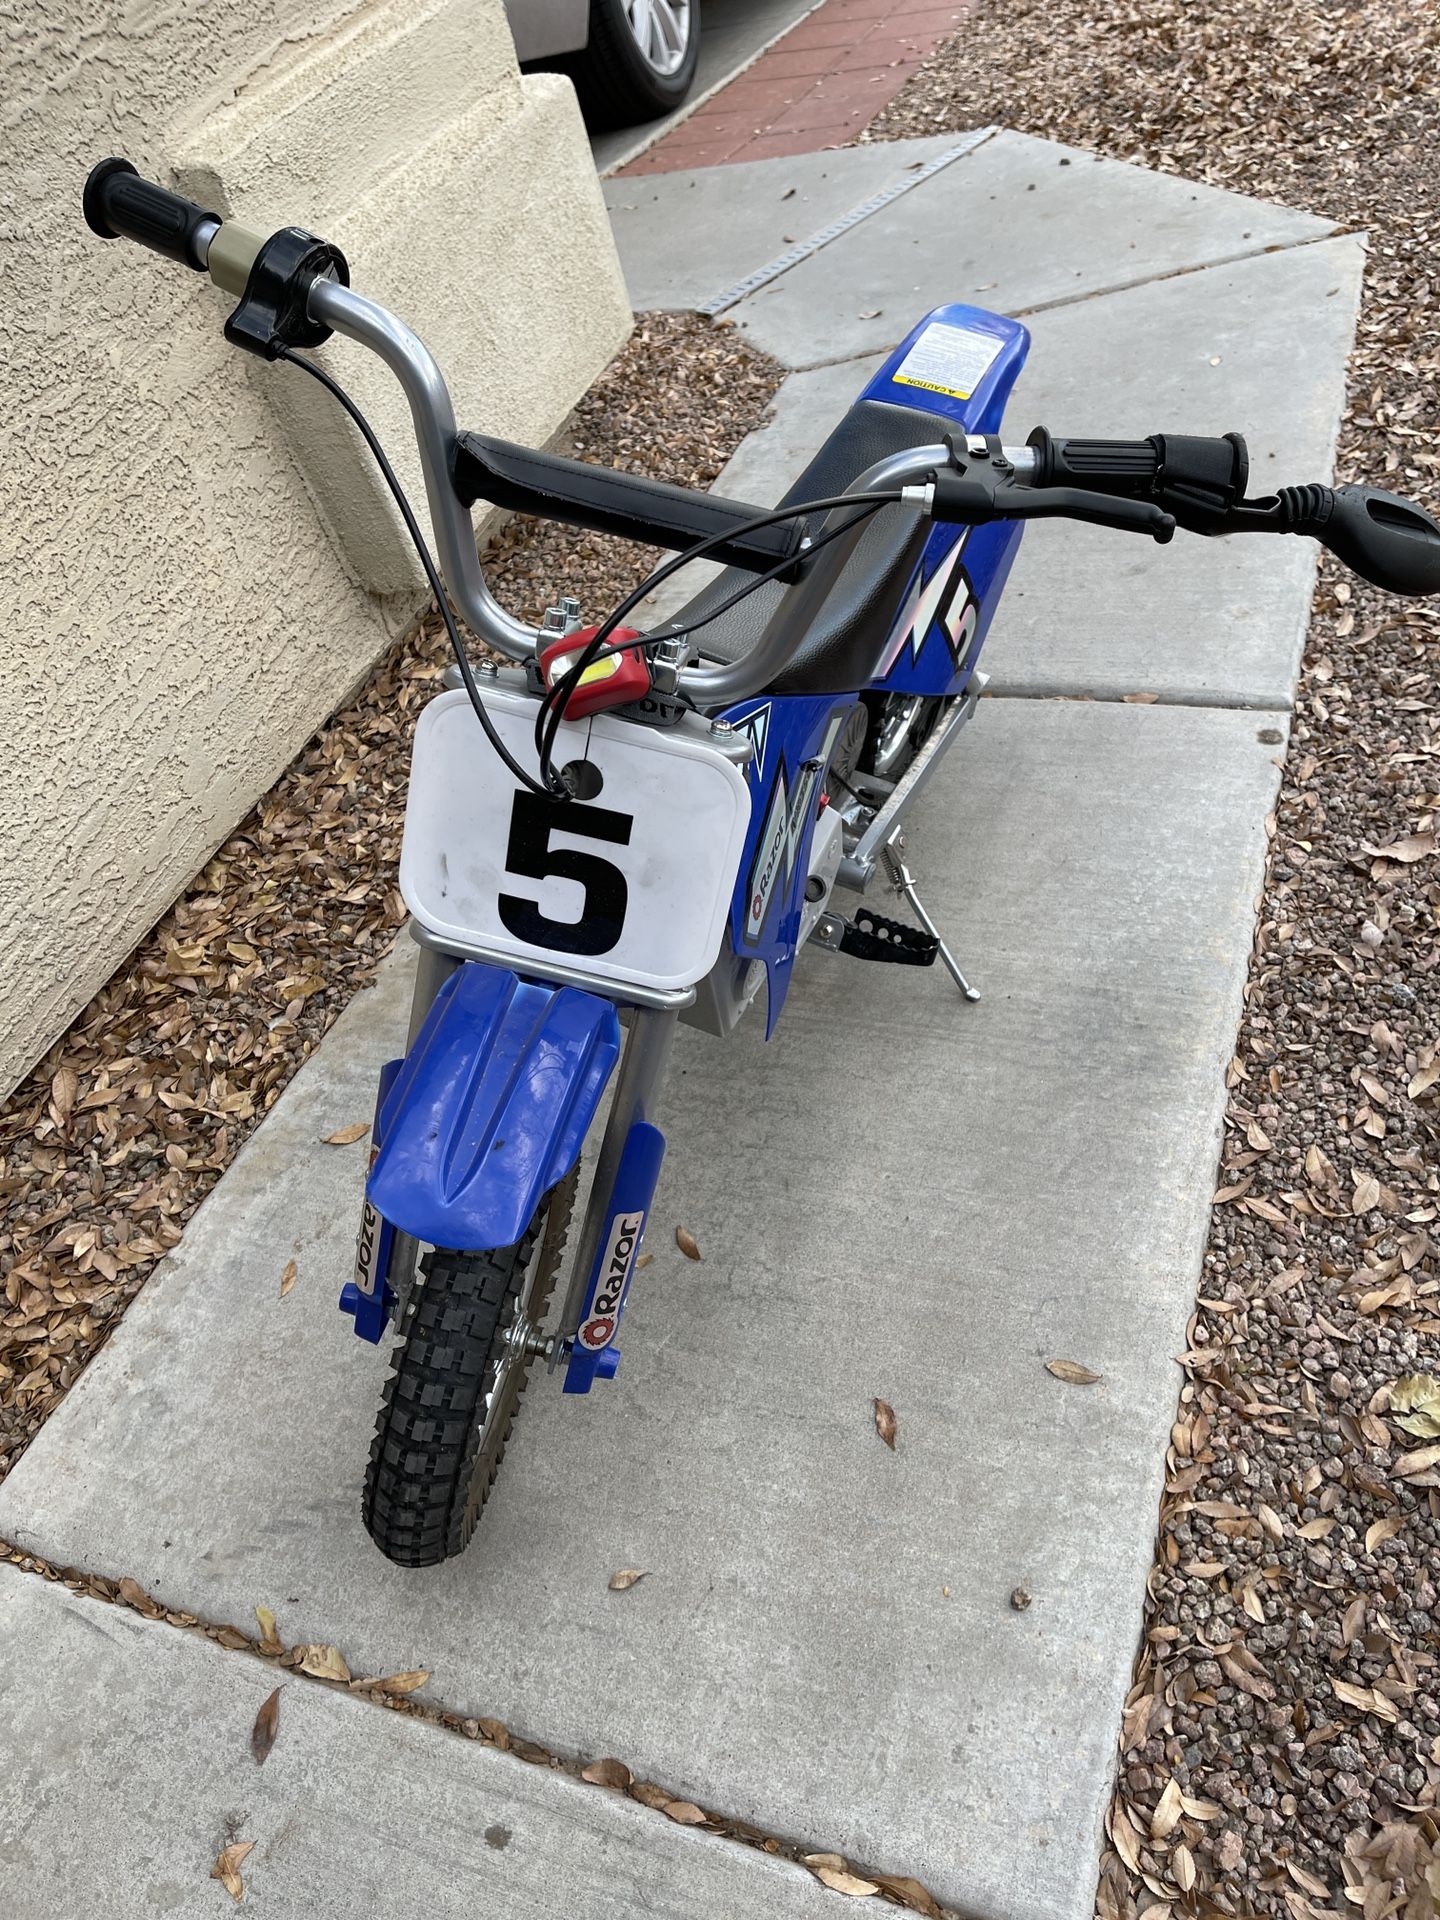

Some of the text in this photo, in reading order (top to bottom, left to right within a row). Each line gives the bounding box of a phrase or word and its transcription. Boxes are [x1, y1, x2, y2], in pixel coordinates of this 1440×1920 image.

[906, 378, 947, 393] CAUTION
[498, 788, 634, 956] 5
[759, 815, 785, 896] Razor
[357, 1203, 376, 1287] azor
[594, 1218, 638, 1315] Razor
